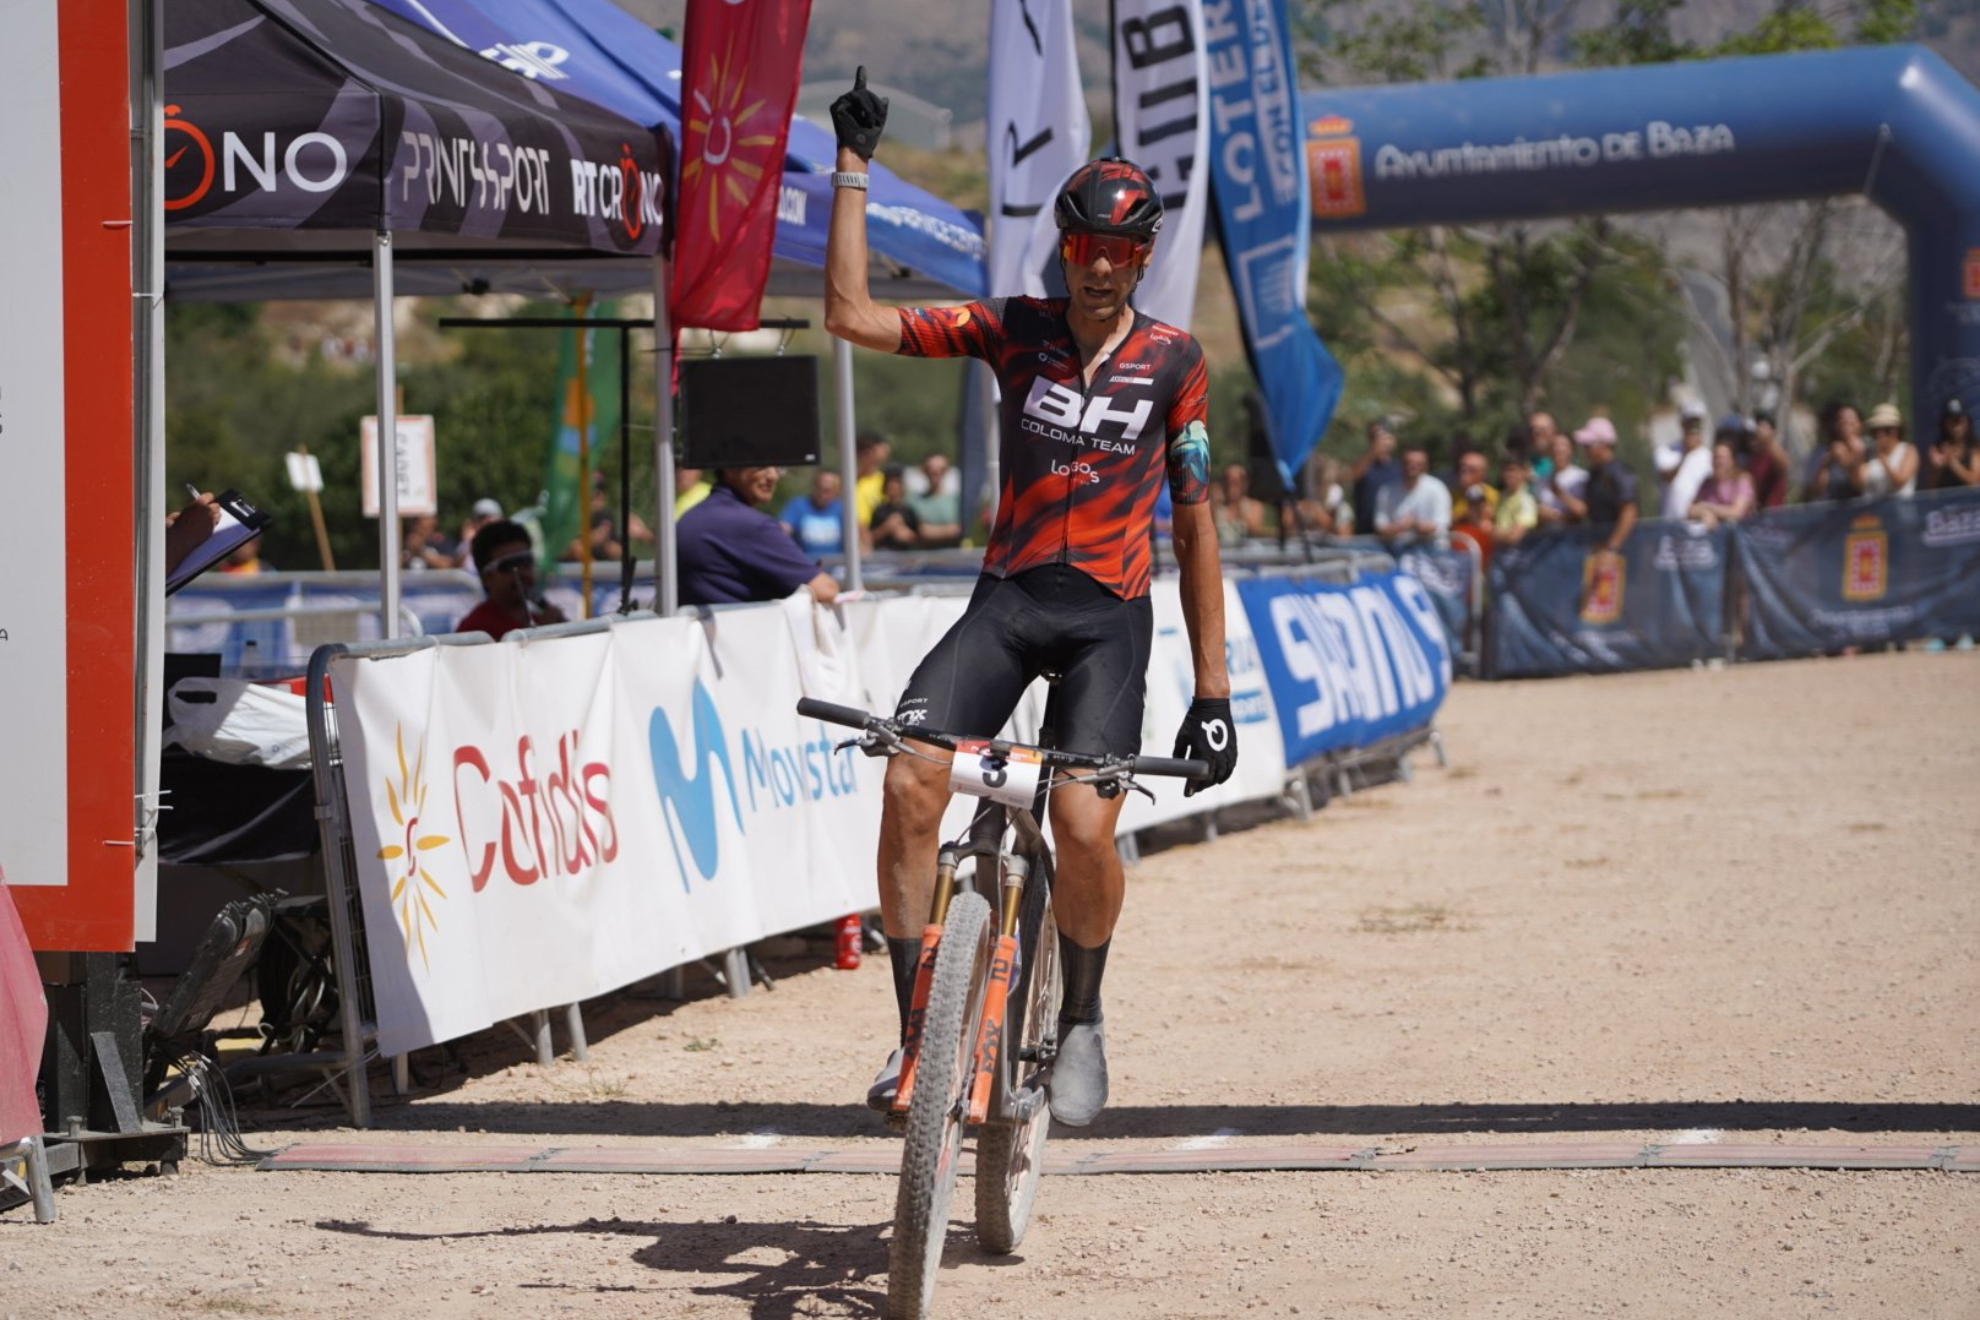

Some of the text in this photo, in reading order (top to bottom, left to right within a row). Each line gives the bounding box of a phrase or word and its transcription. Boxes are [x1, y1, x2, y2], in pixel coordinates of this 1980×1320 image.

[1022, 374, 1154, 440] BH
[1021, 418, 1136, 455] COLOMA TEAM
